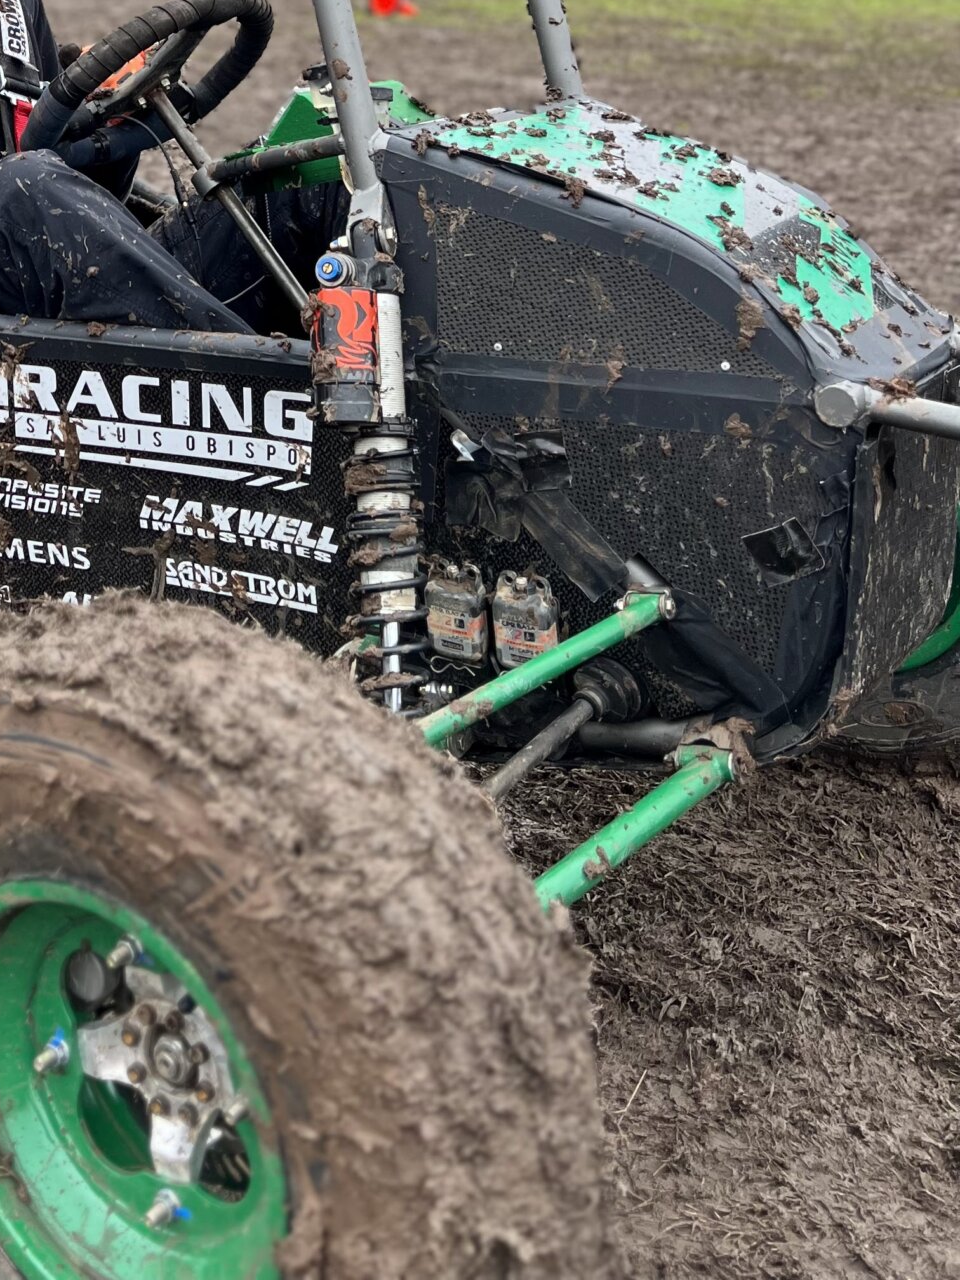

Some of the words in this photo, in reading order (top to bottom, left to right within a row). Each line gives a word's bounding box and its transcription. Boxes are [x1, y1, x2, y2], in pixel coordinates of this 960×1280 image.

[13, 364, 313, 442] RACING
[97, 425, 162, 448] LUIS
[186, 435, 298, 466] OBISPO
[140, 495, 339, 554] MAXWELL
[140, 519, 332, 564] INDUSTRIES
